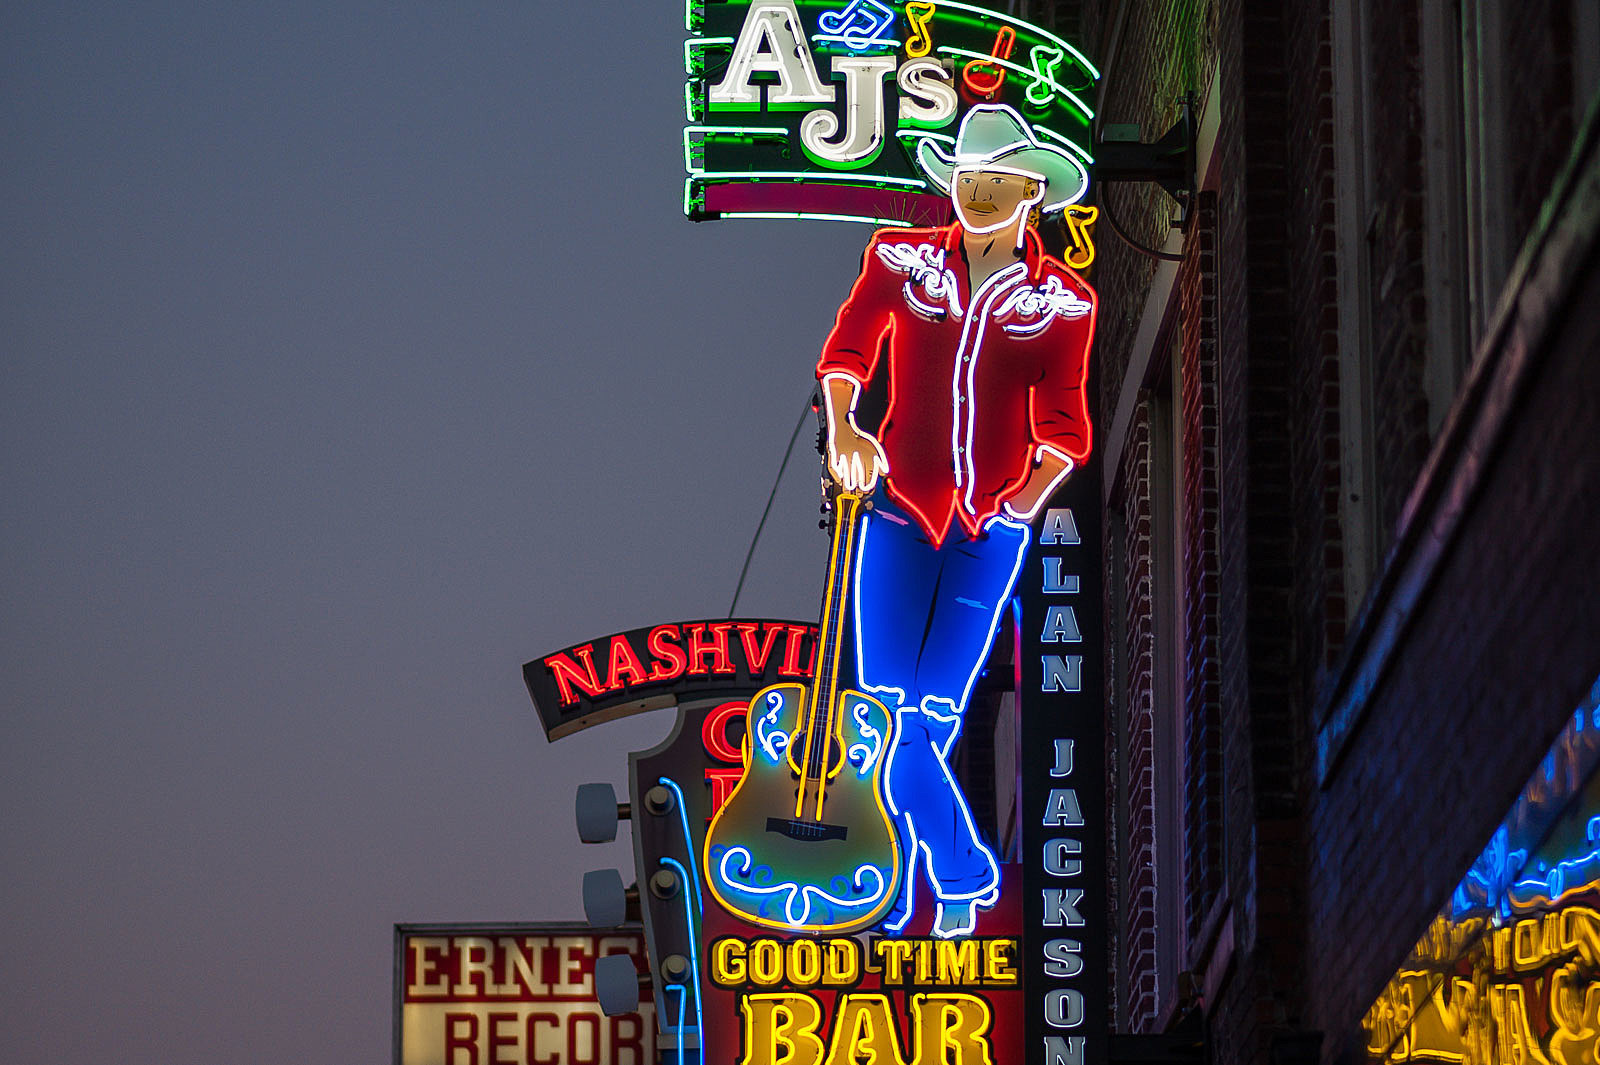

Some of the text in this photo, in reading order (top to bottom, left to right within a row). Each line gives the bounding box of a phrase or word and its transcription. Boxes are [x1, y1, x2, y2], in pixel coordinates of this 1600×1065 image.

[1039, 508, 1086, 1065] ALAN JACKSON
[712, 938, 1018, 986] GOOD TIME
[445, 1011, 658, 1065] RECOR
[741, 993, 993, 1065] BAR
